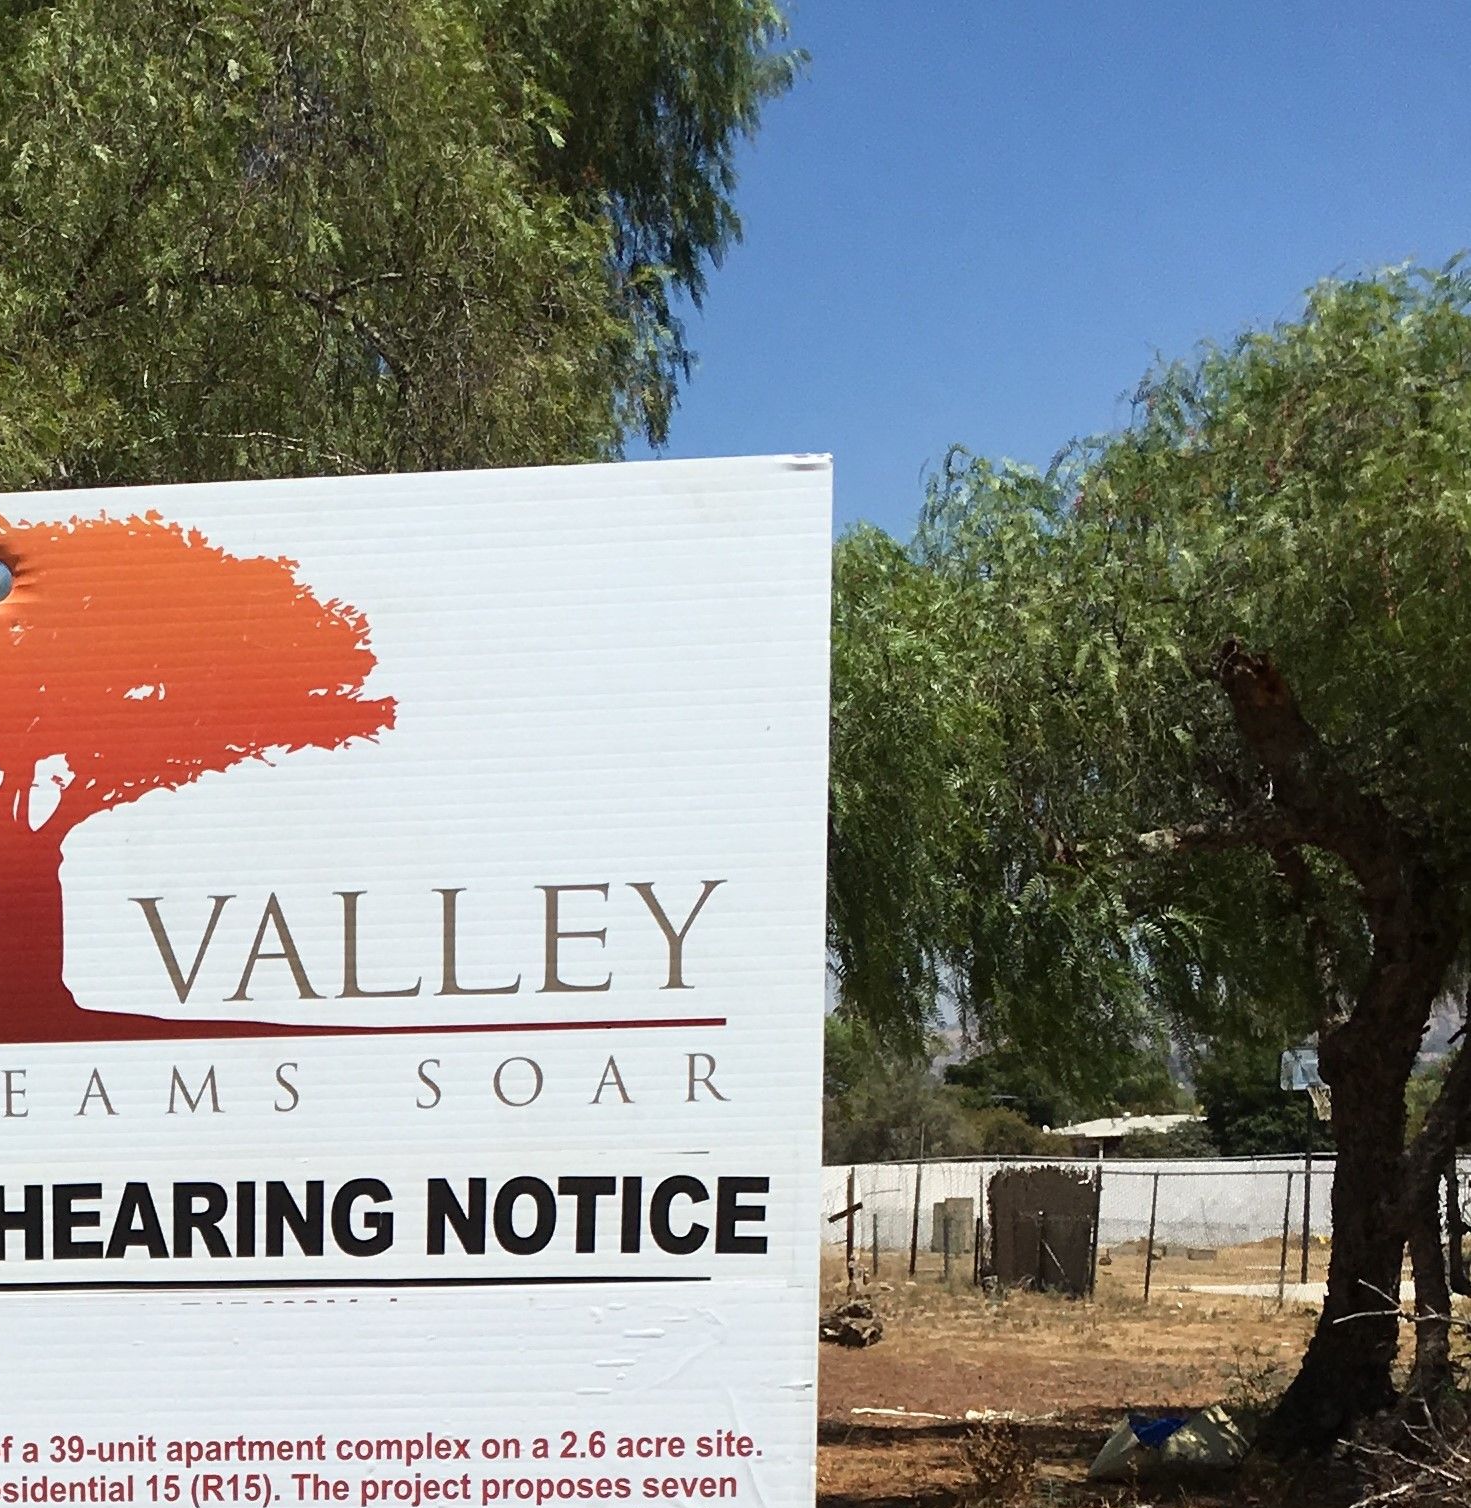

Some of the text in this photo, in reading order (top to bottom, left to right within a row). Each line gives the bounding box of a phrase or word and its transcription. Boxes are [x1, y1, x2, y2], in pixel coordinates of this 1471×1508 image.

[127, 879, 728, 1005] VALLEY
[416, 1052, 731, 1110] SOAR
[426, 1174, 770, 1256] NOTICE
[22, 1442, 39, 1464] a
[49, 1434, 157, 1463] 39-unit
[166, 1434, 327, 1469] apartment
[336, 1431, 471, 1467] complex
[481, 1438, 521, 1460] on
[531, 1437, 549, 1460] a
[559, 1430, 606, 1459] 2.6
[616, 1436, 686, 1459] acre
[695, 1429, 763, 1458] site.
[146, 1474, 181, 1502] 15
[190, 1473, 281, 1508] (R15).
[290, 1473, 350, 1501] The
[360, 1472, 472, 1508] project
[481, 1477, 632, 1507] proposes
[642, 1476, 737, 1499] seven
